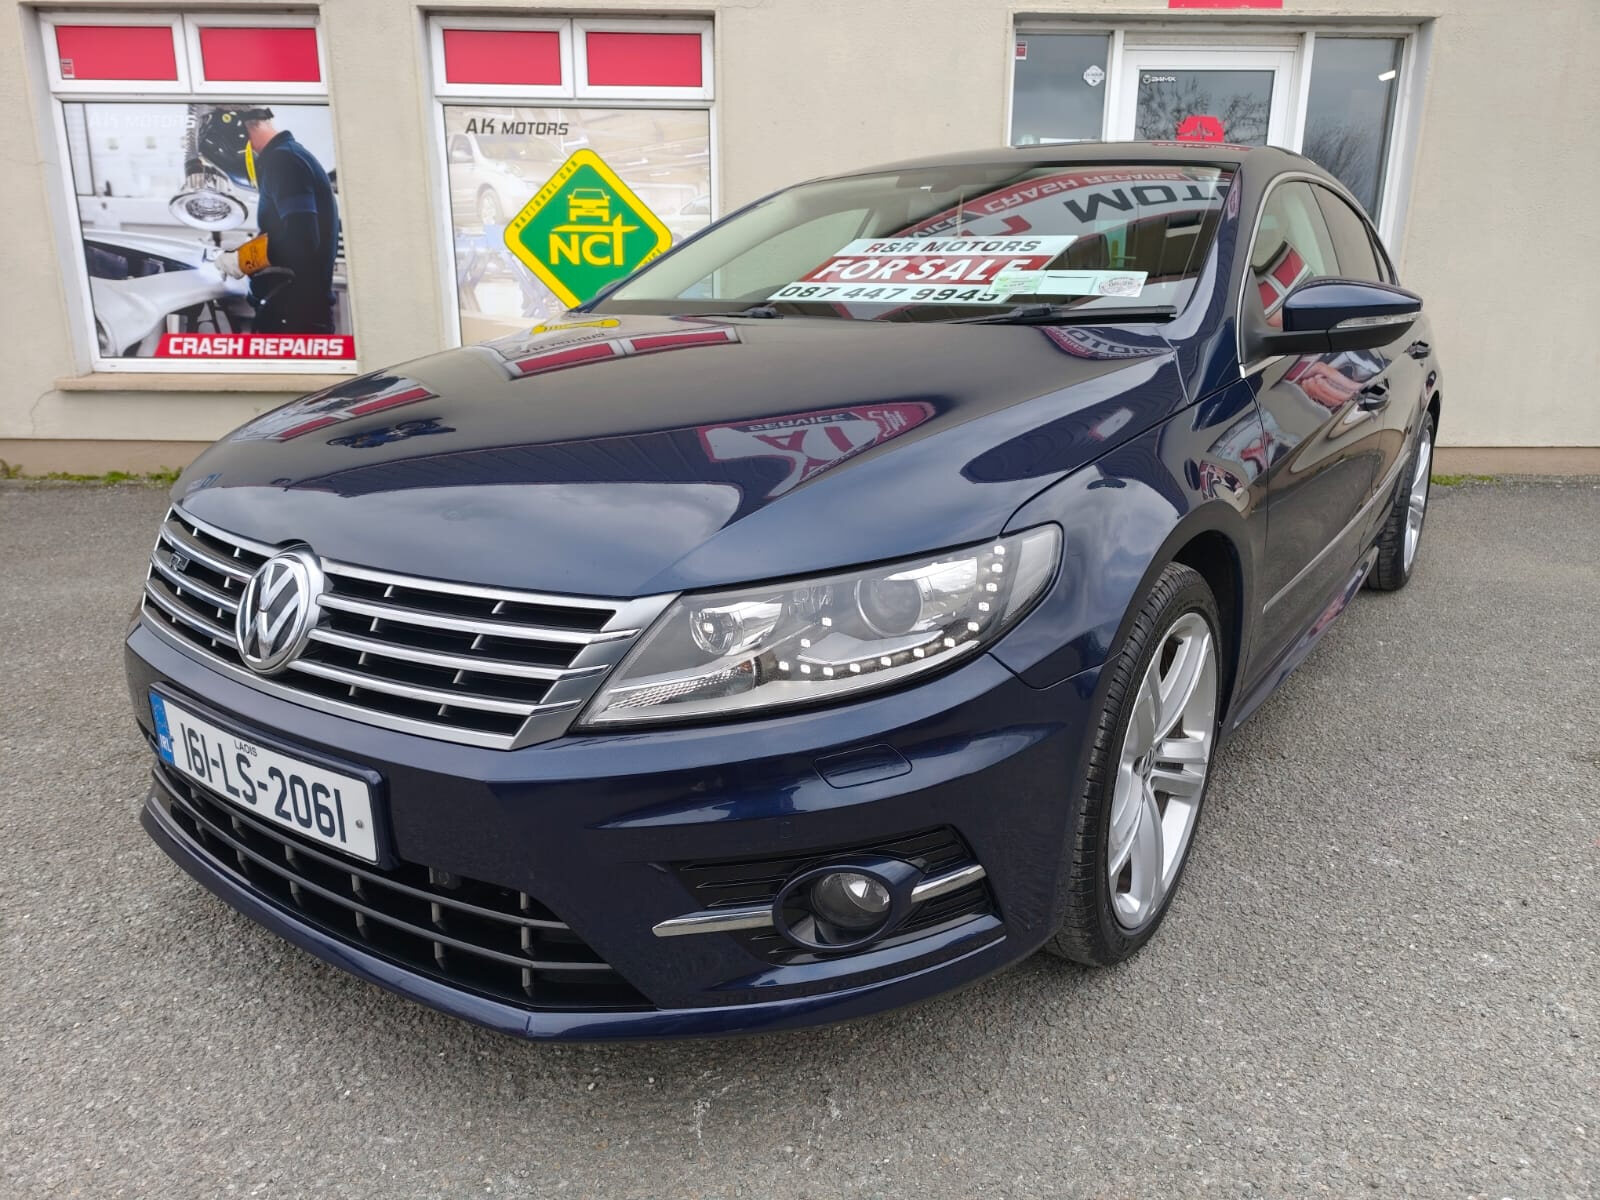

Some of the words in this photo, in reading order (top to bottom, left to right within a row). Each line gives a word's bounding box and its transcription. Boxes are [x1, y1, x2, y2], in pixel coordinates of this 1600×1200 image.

[501, 121, 569, 135] MOTORS
[515, 183, 558, 229] NATIONAL
[559, 160, 578, 180] CAR
[864, 242, 915, 254] R&R
[920, 240, 1042, 254] MOTORS
[812, 259, 905, 281] FOR
[906, 258, 1032, 281] SALE
[778, 286, 836, 298] 087
[842, 287, 906, 300] 447
[169, 337, 244, 355] CRASH
[249, 338, 344, 356] REPAIRS
[159, 734, 172, 753] IRL
[233, 739, 258, 757] LAOIS
[180, 722, 347, 843] 161-LS-2061
